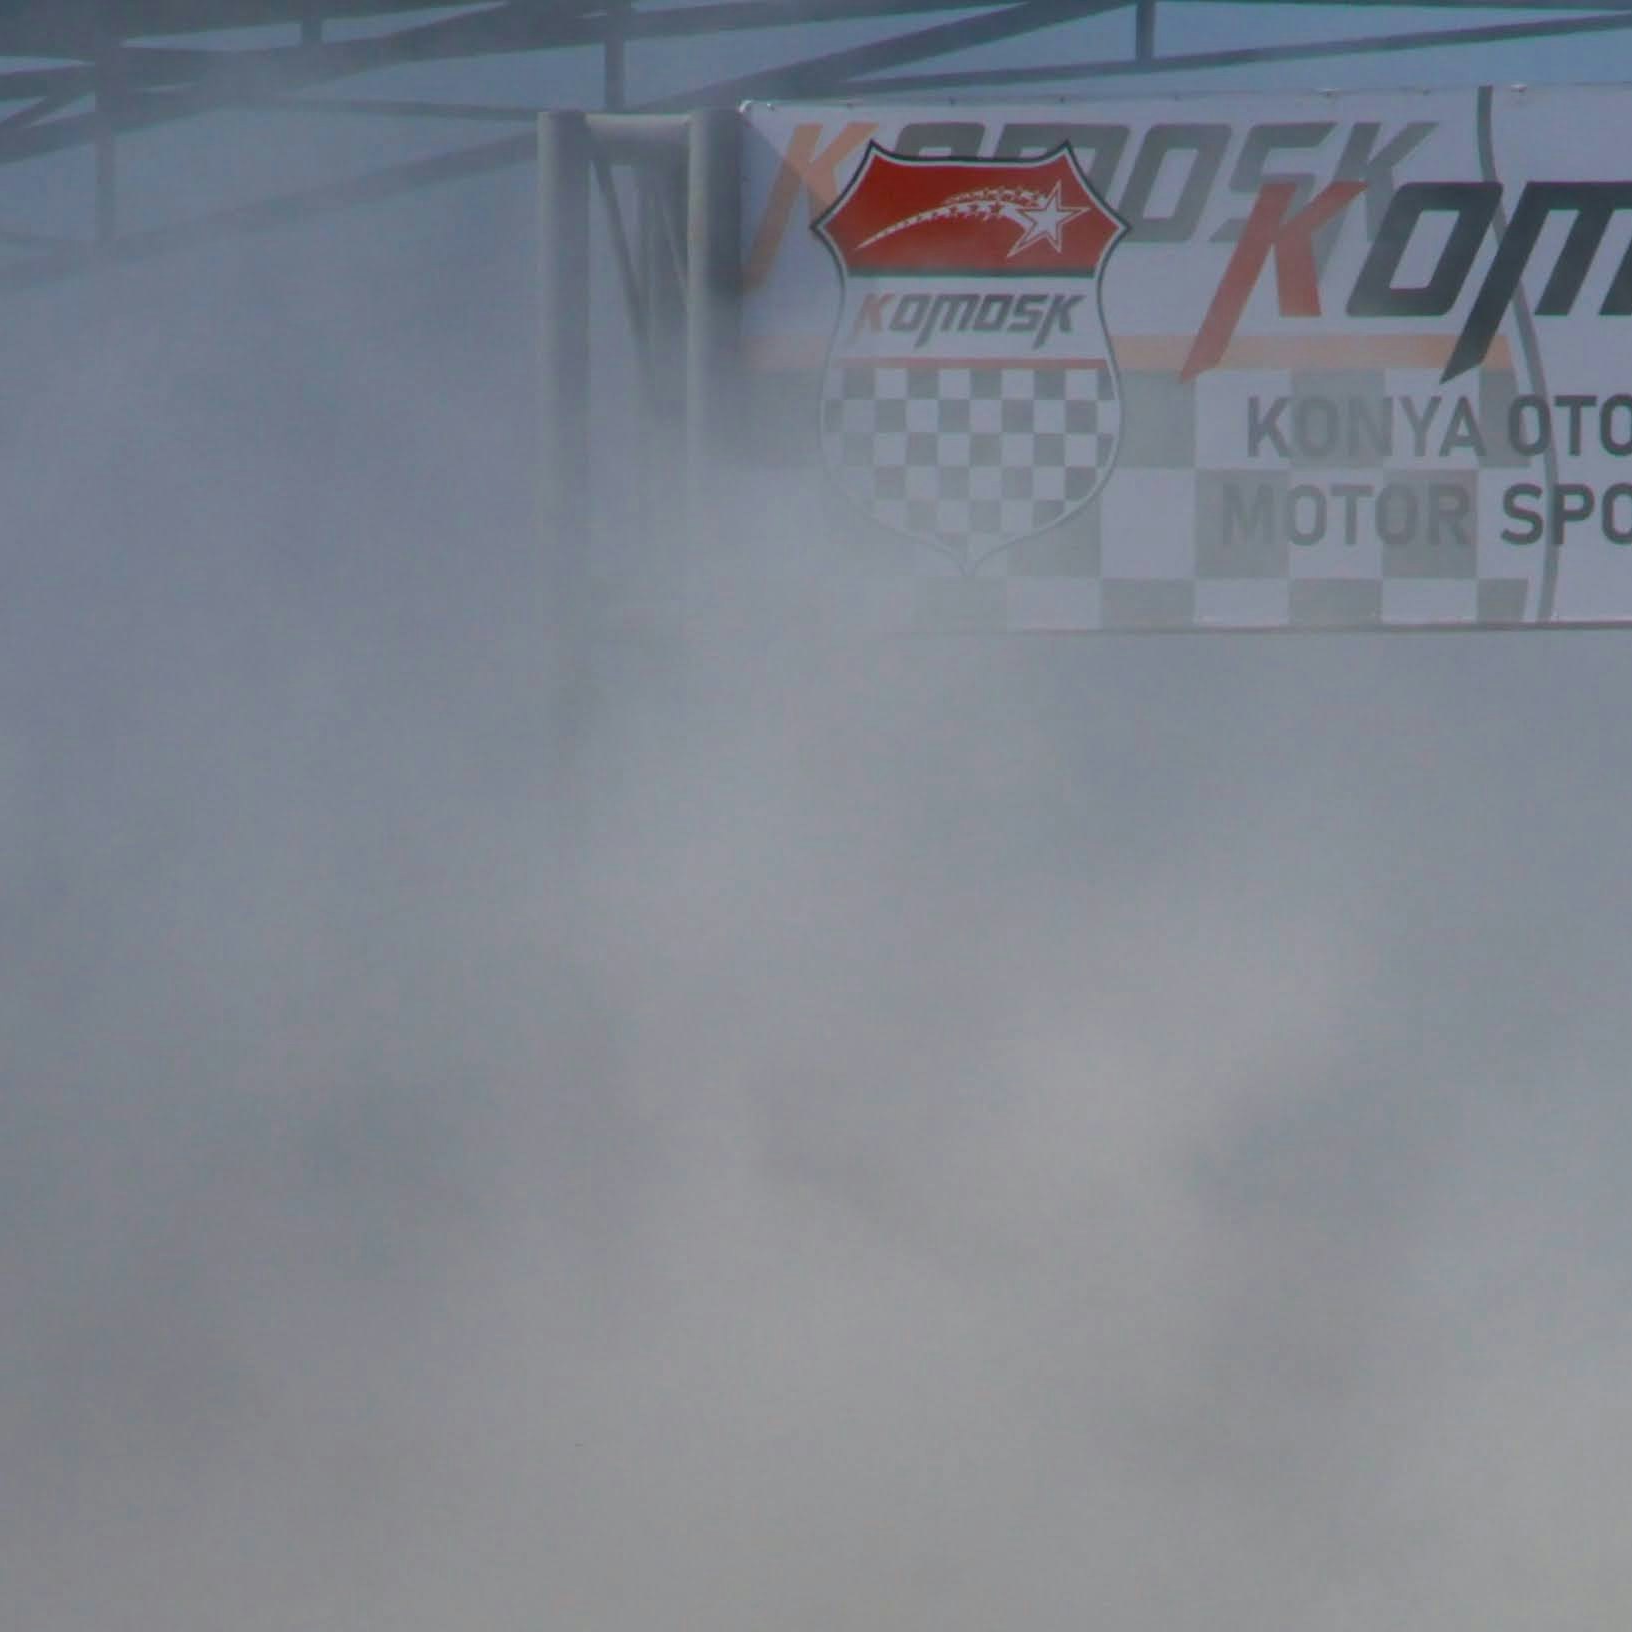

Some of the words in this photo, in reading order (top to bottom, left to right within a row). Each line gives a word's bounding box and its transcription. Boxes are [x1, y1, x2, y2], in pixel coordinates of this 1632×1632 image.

[743, 120, 1439, 293] KOSK
[853, 292, 1085, 350] KOMOSK
[1247, 396, 1486, 458] KONYA
[1220, 484, 1472, 546] MOTOR
